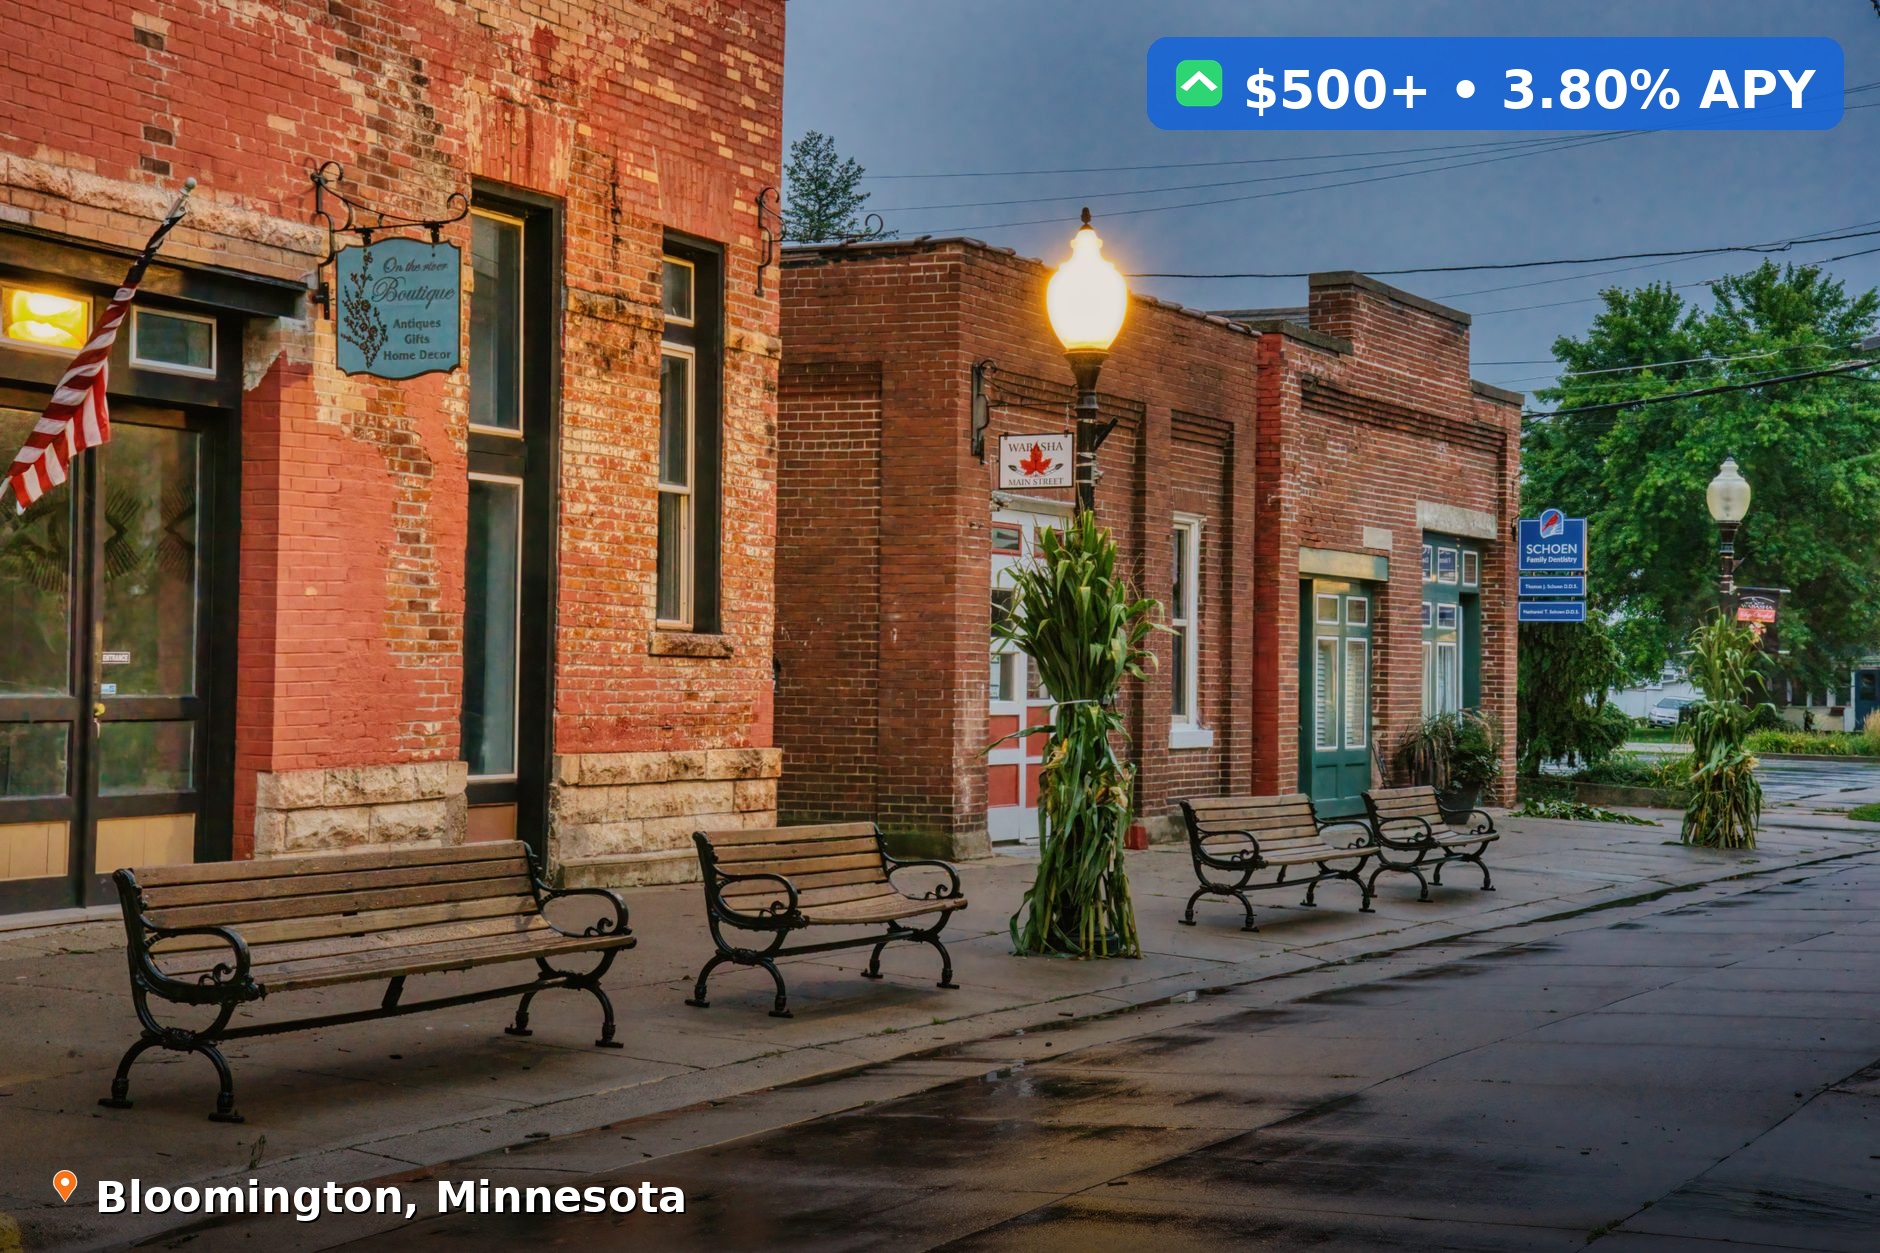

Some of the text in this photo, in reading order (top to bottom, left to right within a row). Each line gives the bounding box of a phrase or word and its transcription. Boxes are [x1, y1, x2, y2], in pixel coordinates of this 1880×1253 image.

[383, 256, 448, 273] On the river
[371, 276, 456, 309] Boutique
[393, 317, 441, 330] Antiques
[404, 334, 430, 345] Gifts
[383, 349, 452, 361] Home Decor
[1526, 544, 1577, 554] SCHOEN
